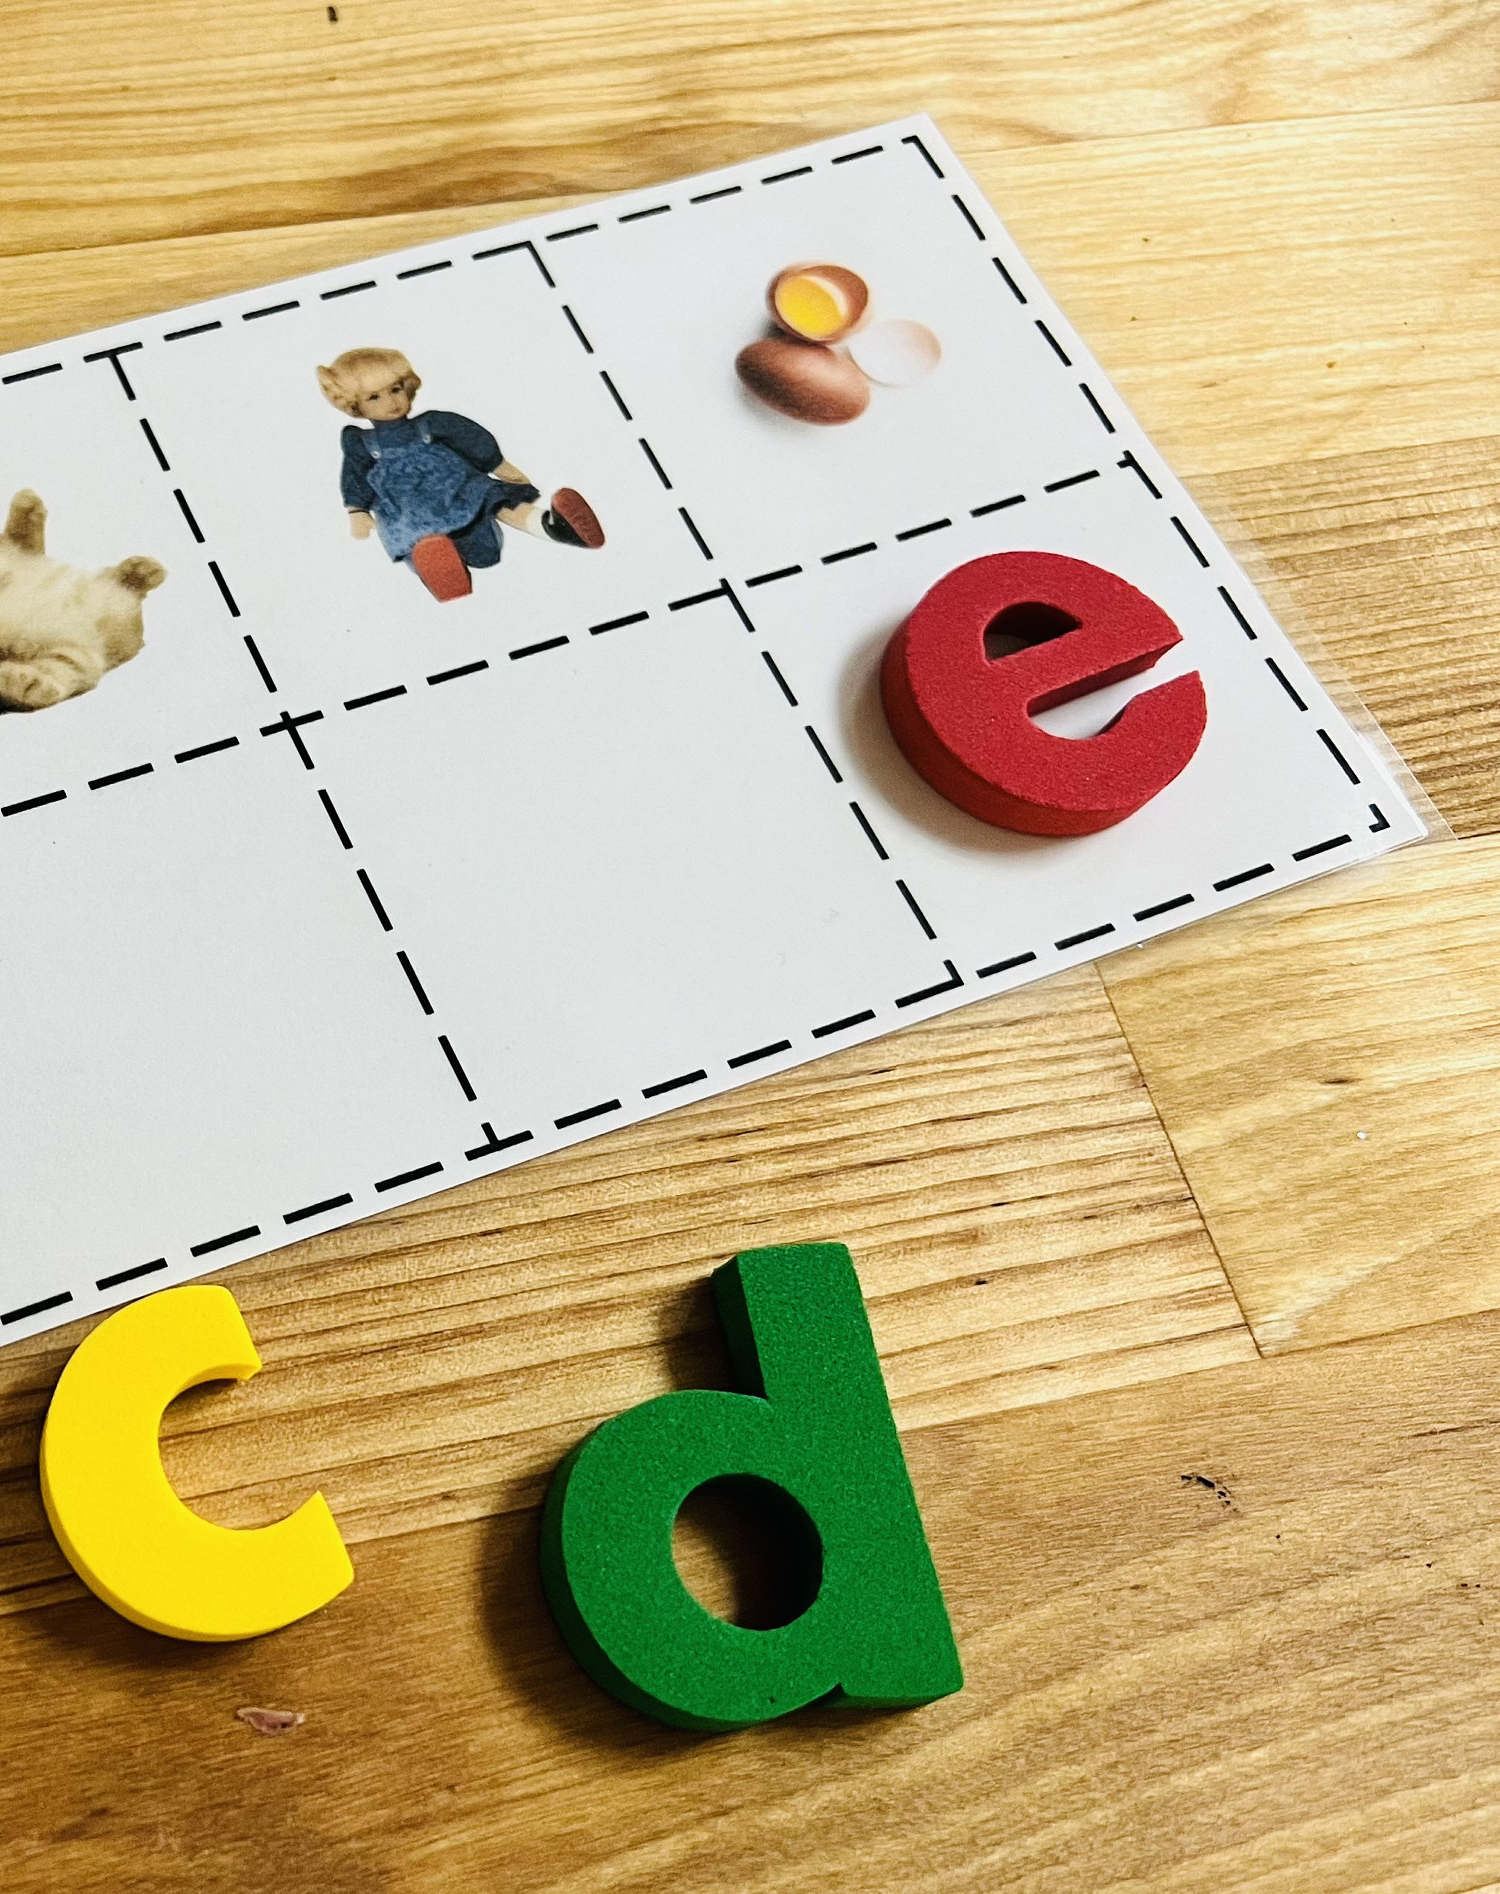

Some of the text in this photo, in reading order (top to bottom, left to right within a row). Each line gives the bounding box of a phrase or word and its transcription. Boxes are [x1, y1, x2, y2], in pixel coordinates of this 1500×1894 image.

[880, 550, 1208, 838] e
[39, 1284, 355, 1643] c
[540, 1241, 963, 1732] d
